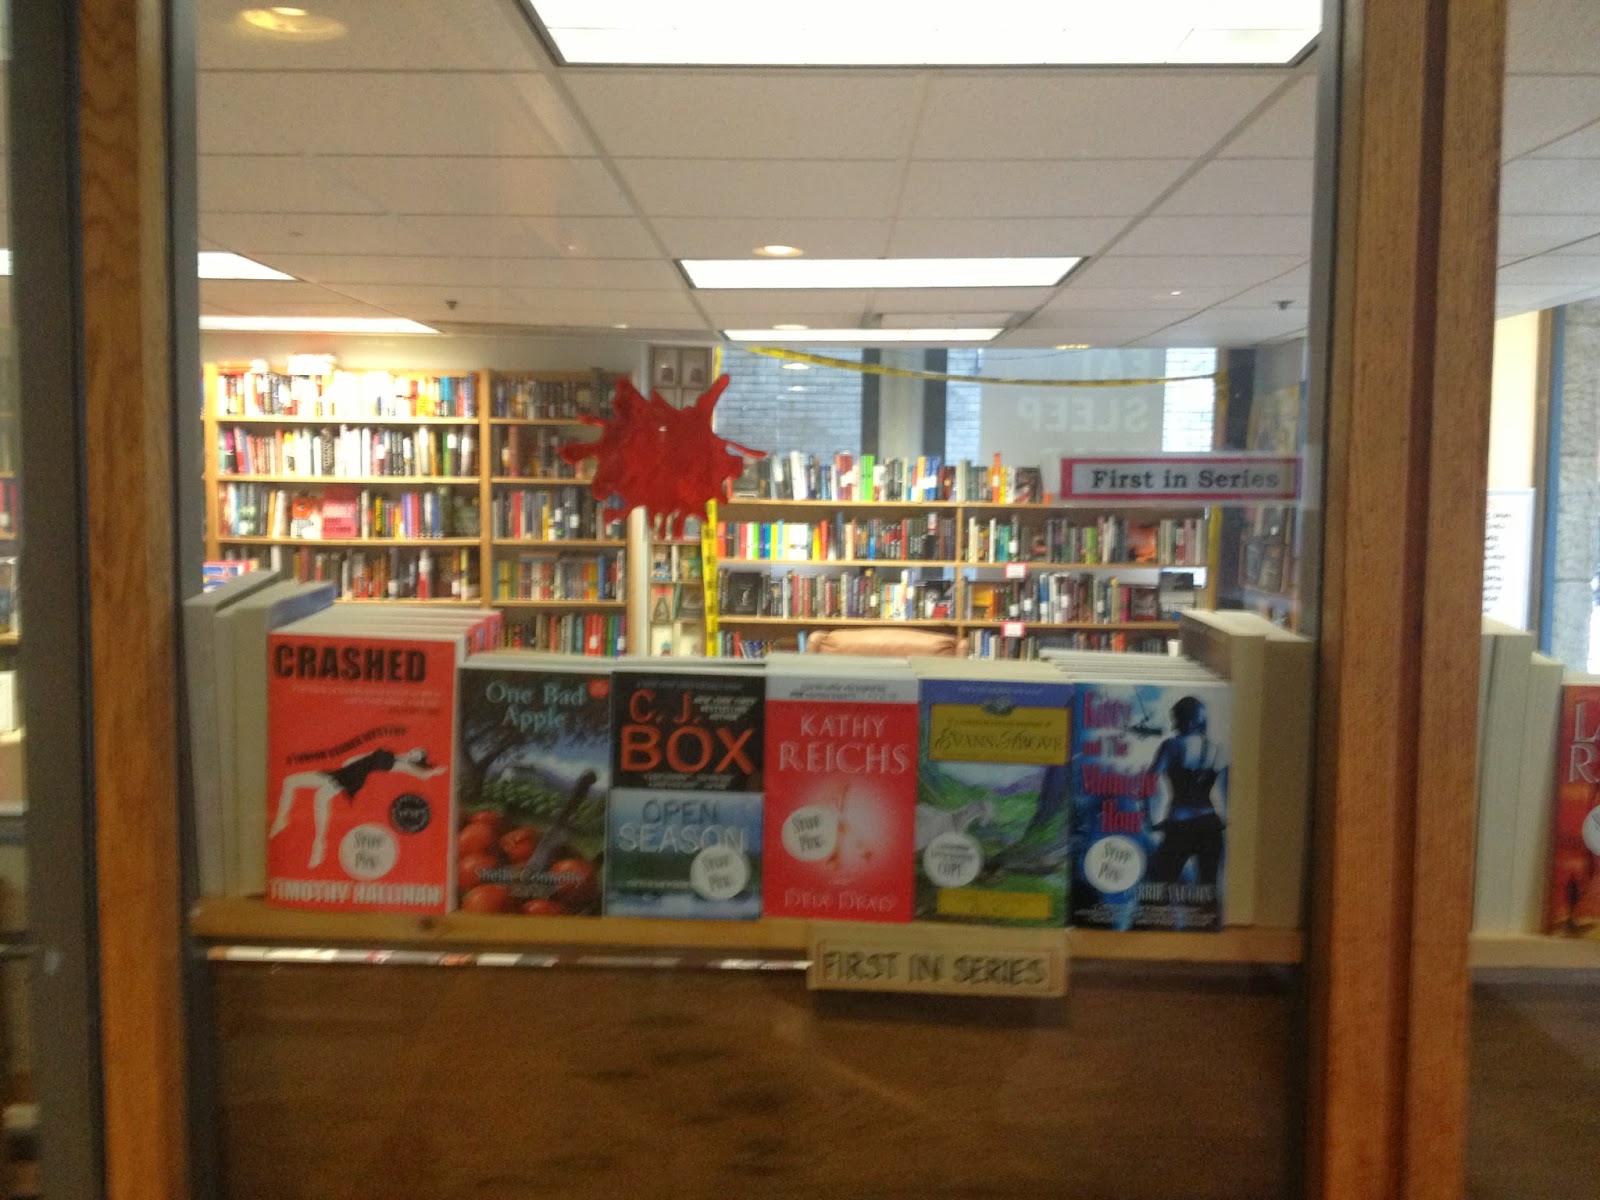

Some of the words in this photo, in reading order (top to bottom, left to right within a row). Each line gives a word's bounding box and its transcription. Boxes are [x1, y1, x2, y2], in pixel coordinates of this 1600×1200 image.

[1091, 469, 1153, 489] First
[1163, 469, 1188, 489] in
[1198, 470, 1279, 490] Series
[273, 644, 427, 683] CRASHED
[486, 681, 533, 705] One
[543, 682, 586, 706] Bad
[502, 704, 567, 733] Apple
[800, 714, 888, 738] KATHY
[621, 724, 754, 775] BOX
[778, 740, 911, 775] REICHS
[642, 800, 719, 824] OPEN
[618, 822, 748, 854] SEASON
[822, 951, 901, 979] FIRST
[907, 953, 941, 982] IN
[952, 955, 1045, 985] SERIES
